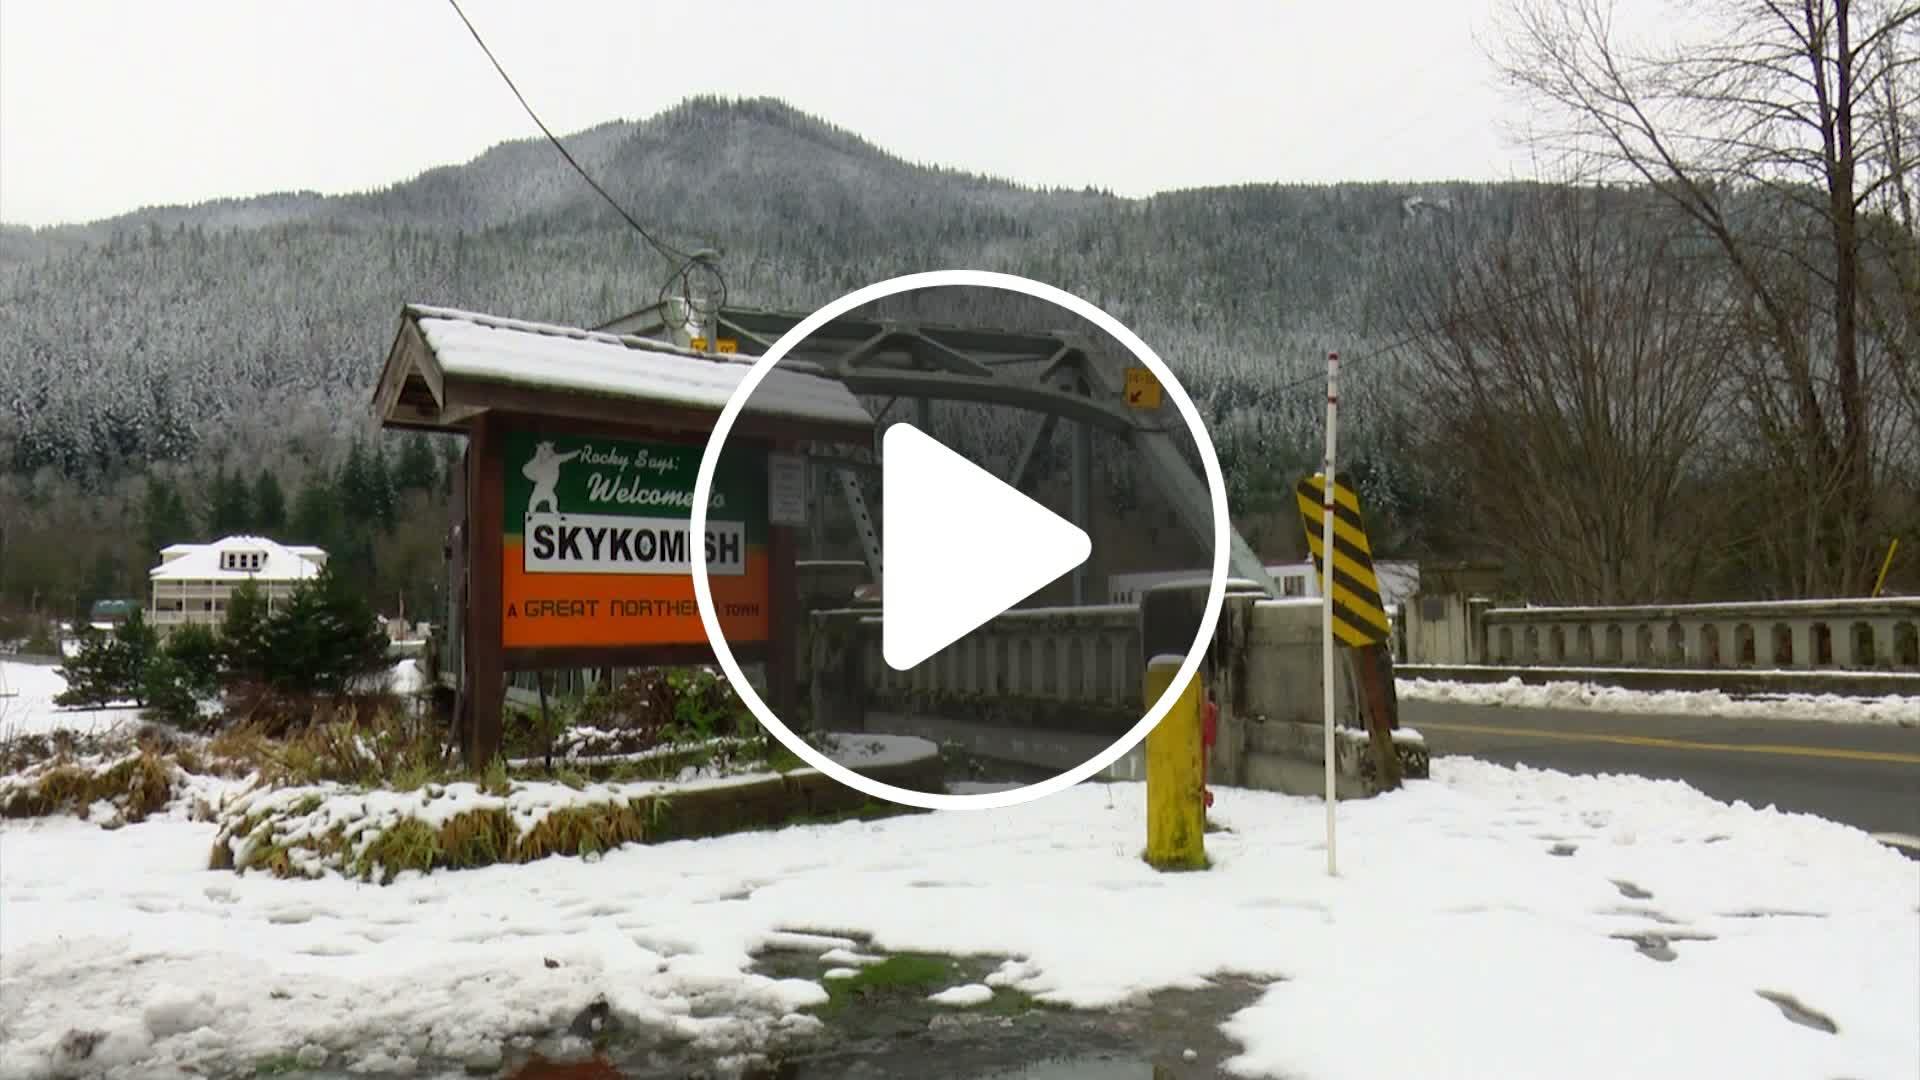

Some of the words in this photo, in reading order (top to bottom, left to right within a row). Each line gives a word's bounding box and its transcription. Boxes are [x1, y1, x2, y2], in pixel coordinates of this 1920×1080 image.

[580, 444, 629, 472] Rocky
[634, 449, 680, 475] Says:
[587, 472, 695, 505] Welcome
[507, 603, 517, 617] A
[524, 599, 599, 617] GREAT
[610, 599, 719, 617] NORTHE
